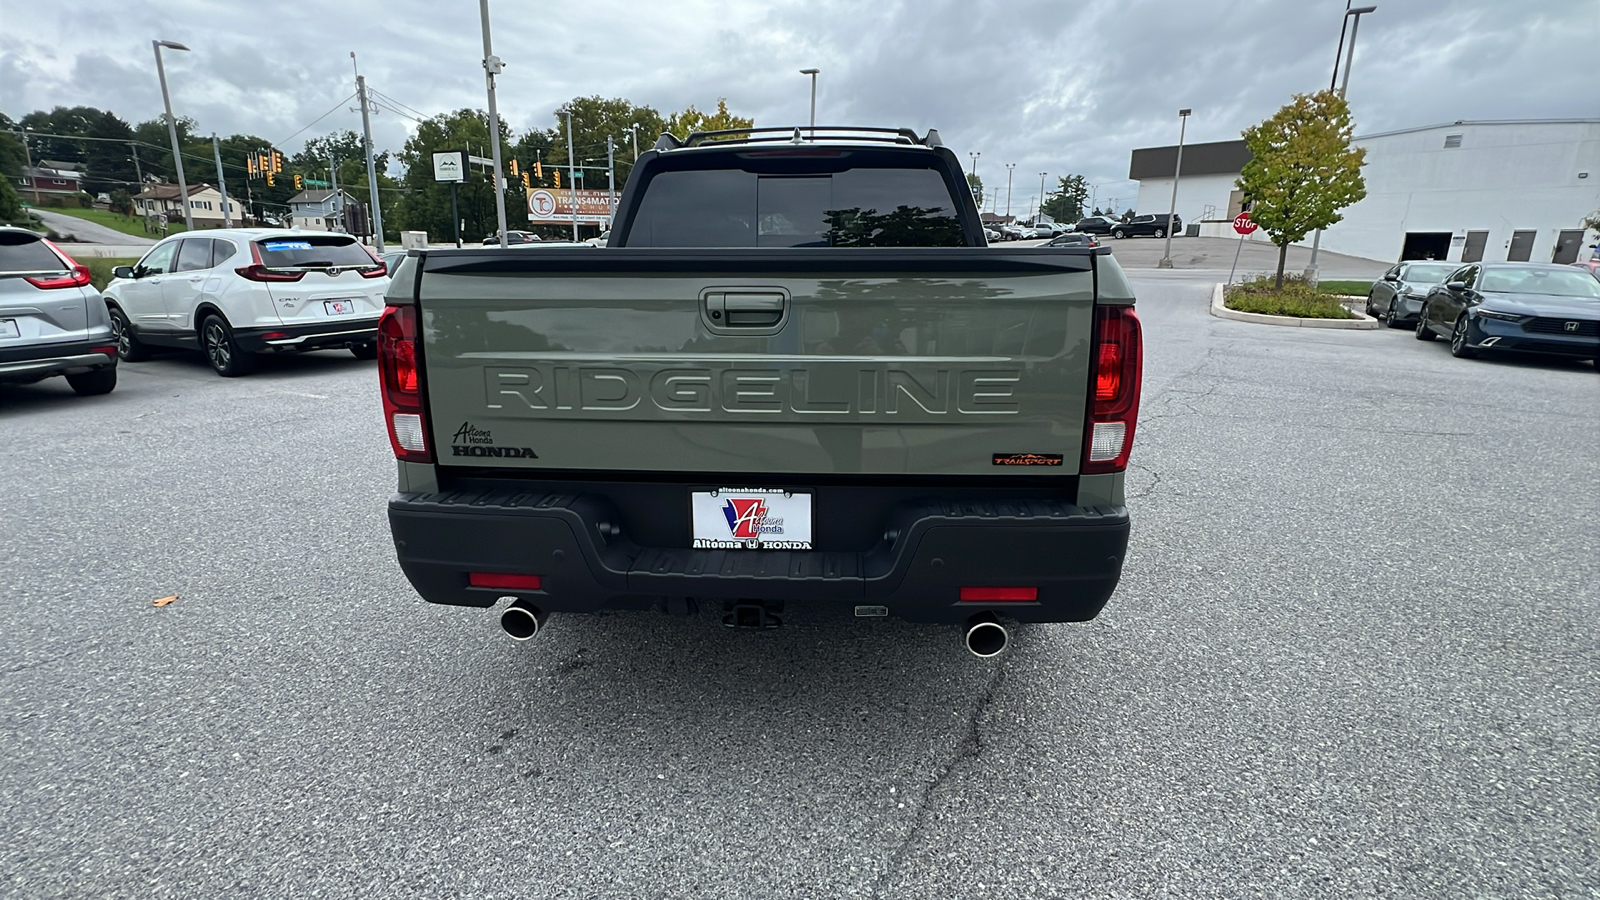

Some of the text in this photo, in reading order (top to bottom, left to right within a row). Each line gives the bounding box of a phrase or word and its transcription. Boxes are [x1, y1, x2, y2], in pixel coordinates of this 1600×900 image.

[557, 196, 621, 205] TRANS4MATO
[484, 366, 1020, 414] RIDGELINE
[469, 436, 493, 444] Honda
[451, 445, 539, 459] HONDA
[995, 458, 1061, 466] TRAILSPORT
[753, 525, 783, 533] Honda
[693, 540, 812, 550] Altoona HONDA
